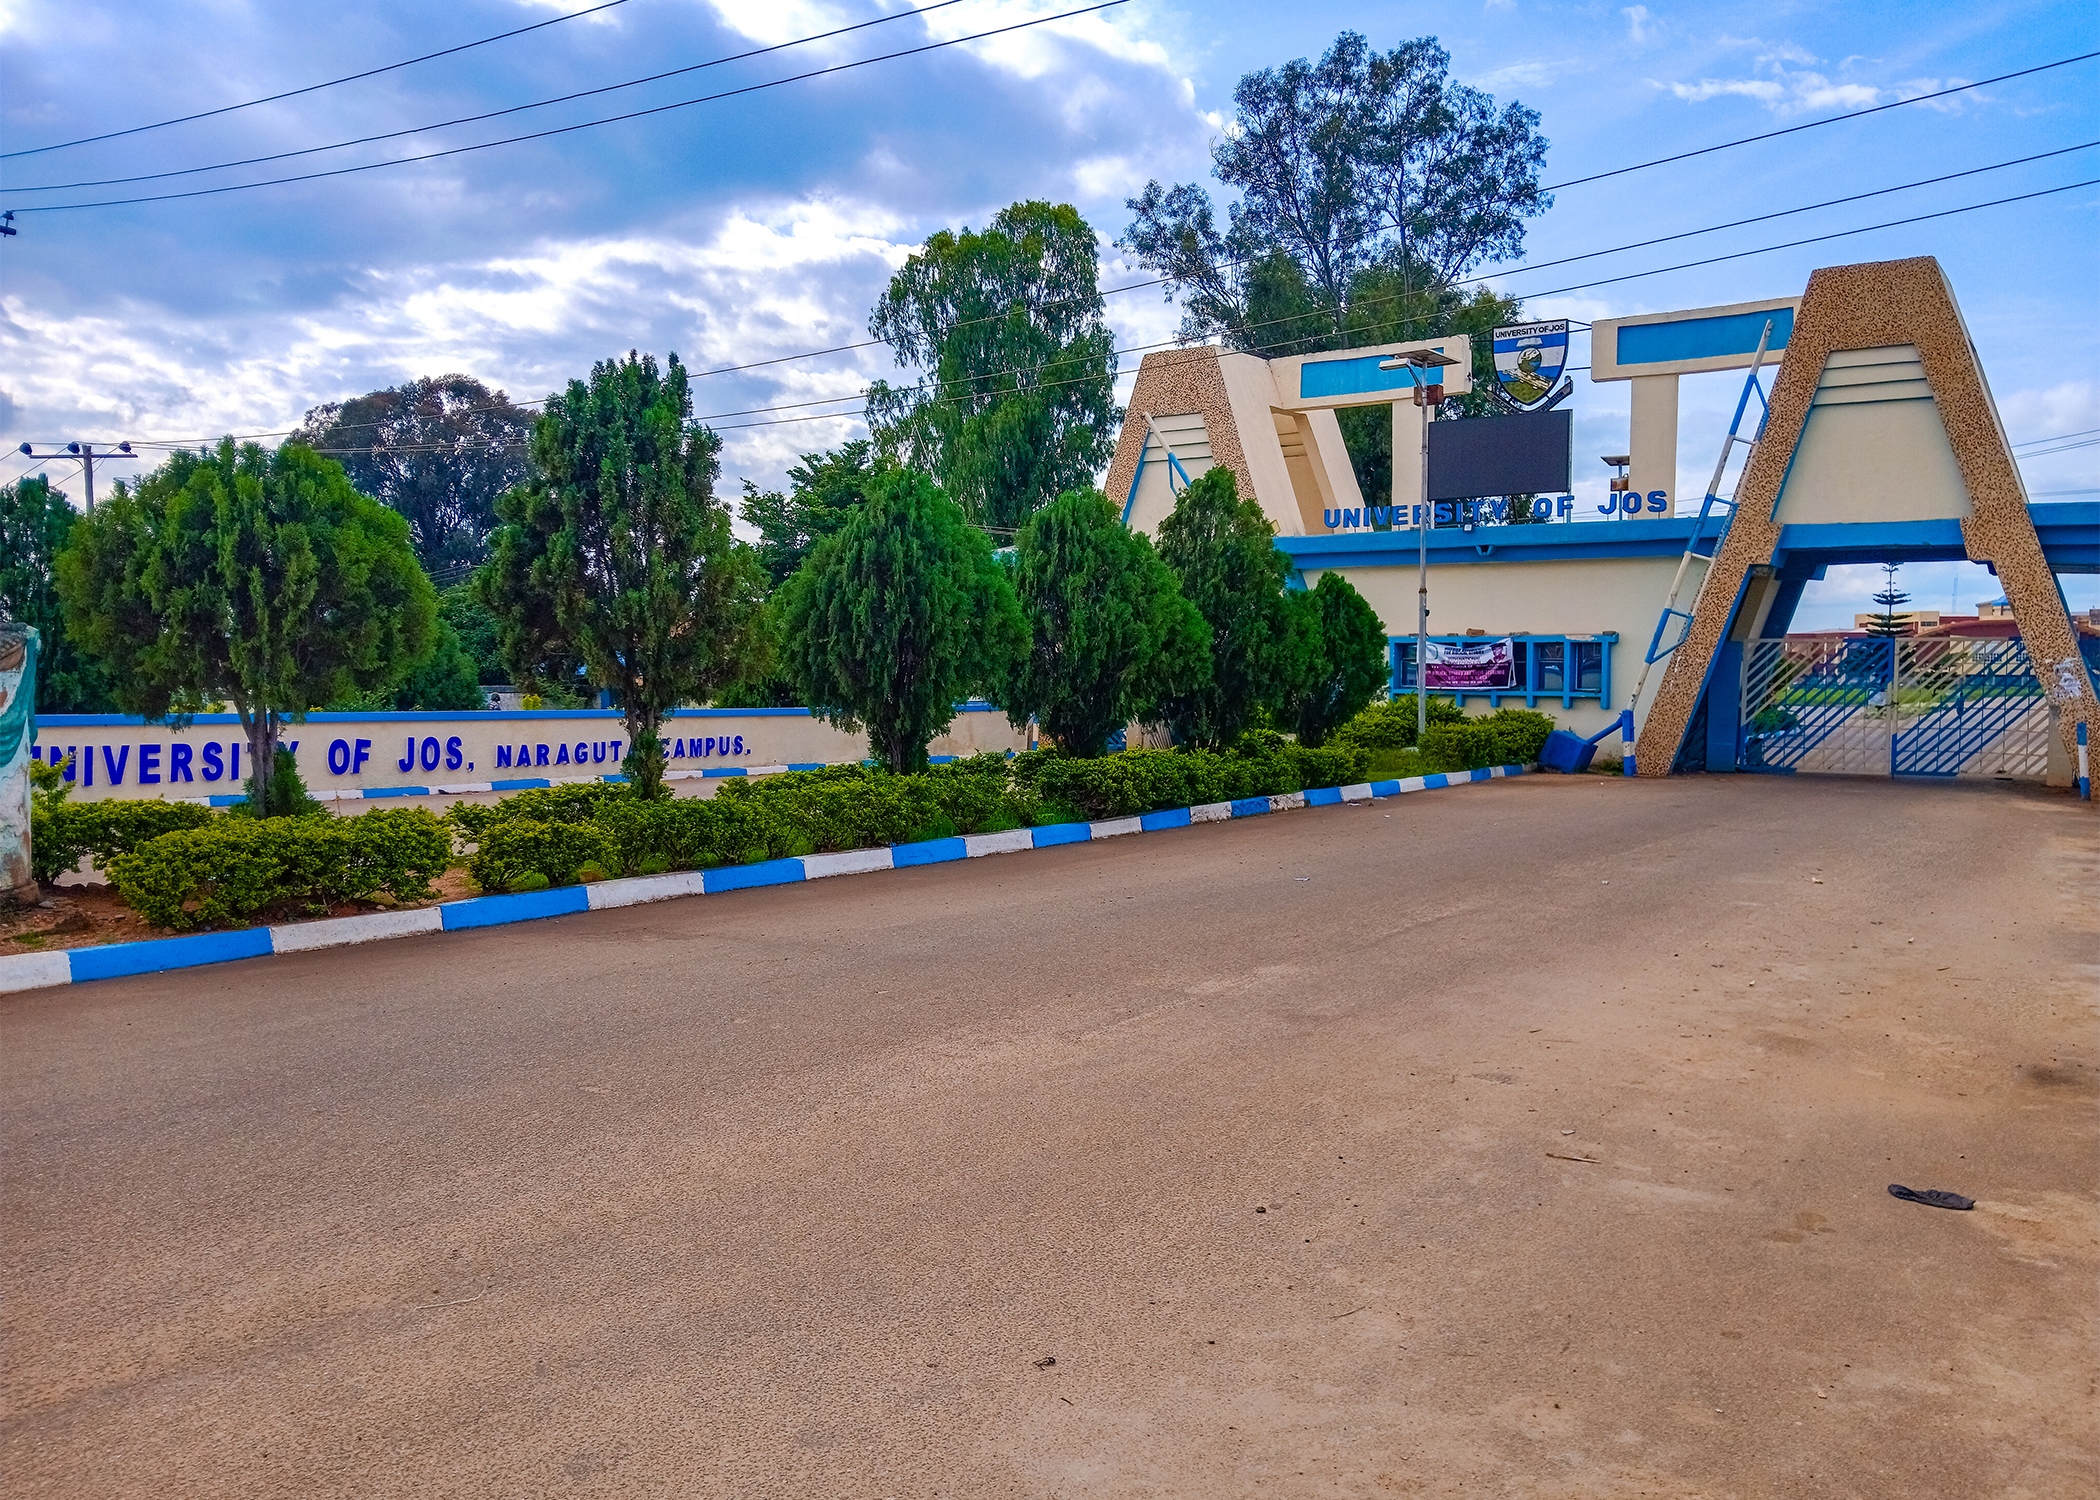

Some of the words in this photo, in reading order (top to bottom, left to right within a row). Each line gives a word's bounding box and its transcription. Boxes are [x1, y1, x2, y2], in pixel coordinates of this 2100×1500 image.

[1495, 327, 1539, 338] UNIVERSITY
[1538, 325, 1548, 333] OF
[1549, 323, 1565, 332] JOS
[1323, 500, 1508, 528] UNIVERSITY
[1533, 495, 1575, 518] OF
[1597, 490, 1668, 515] JOS
[32, 741, 299, 786] NIVERSI
[327, 738, 372, 775] OF
[397, 735, 474, 773] JOS,
[495, 740, 634, 768] NARAGUT
